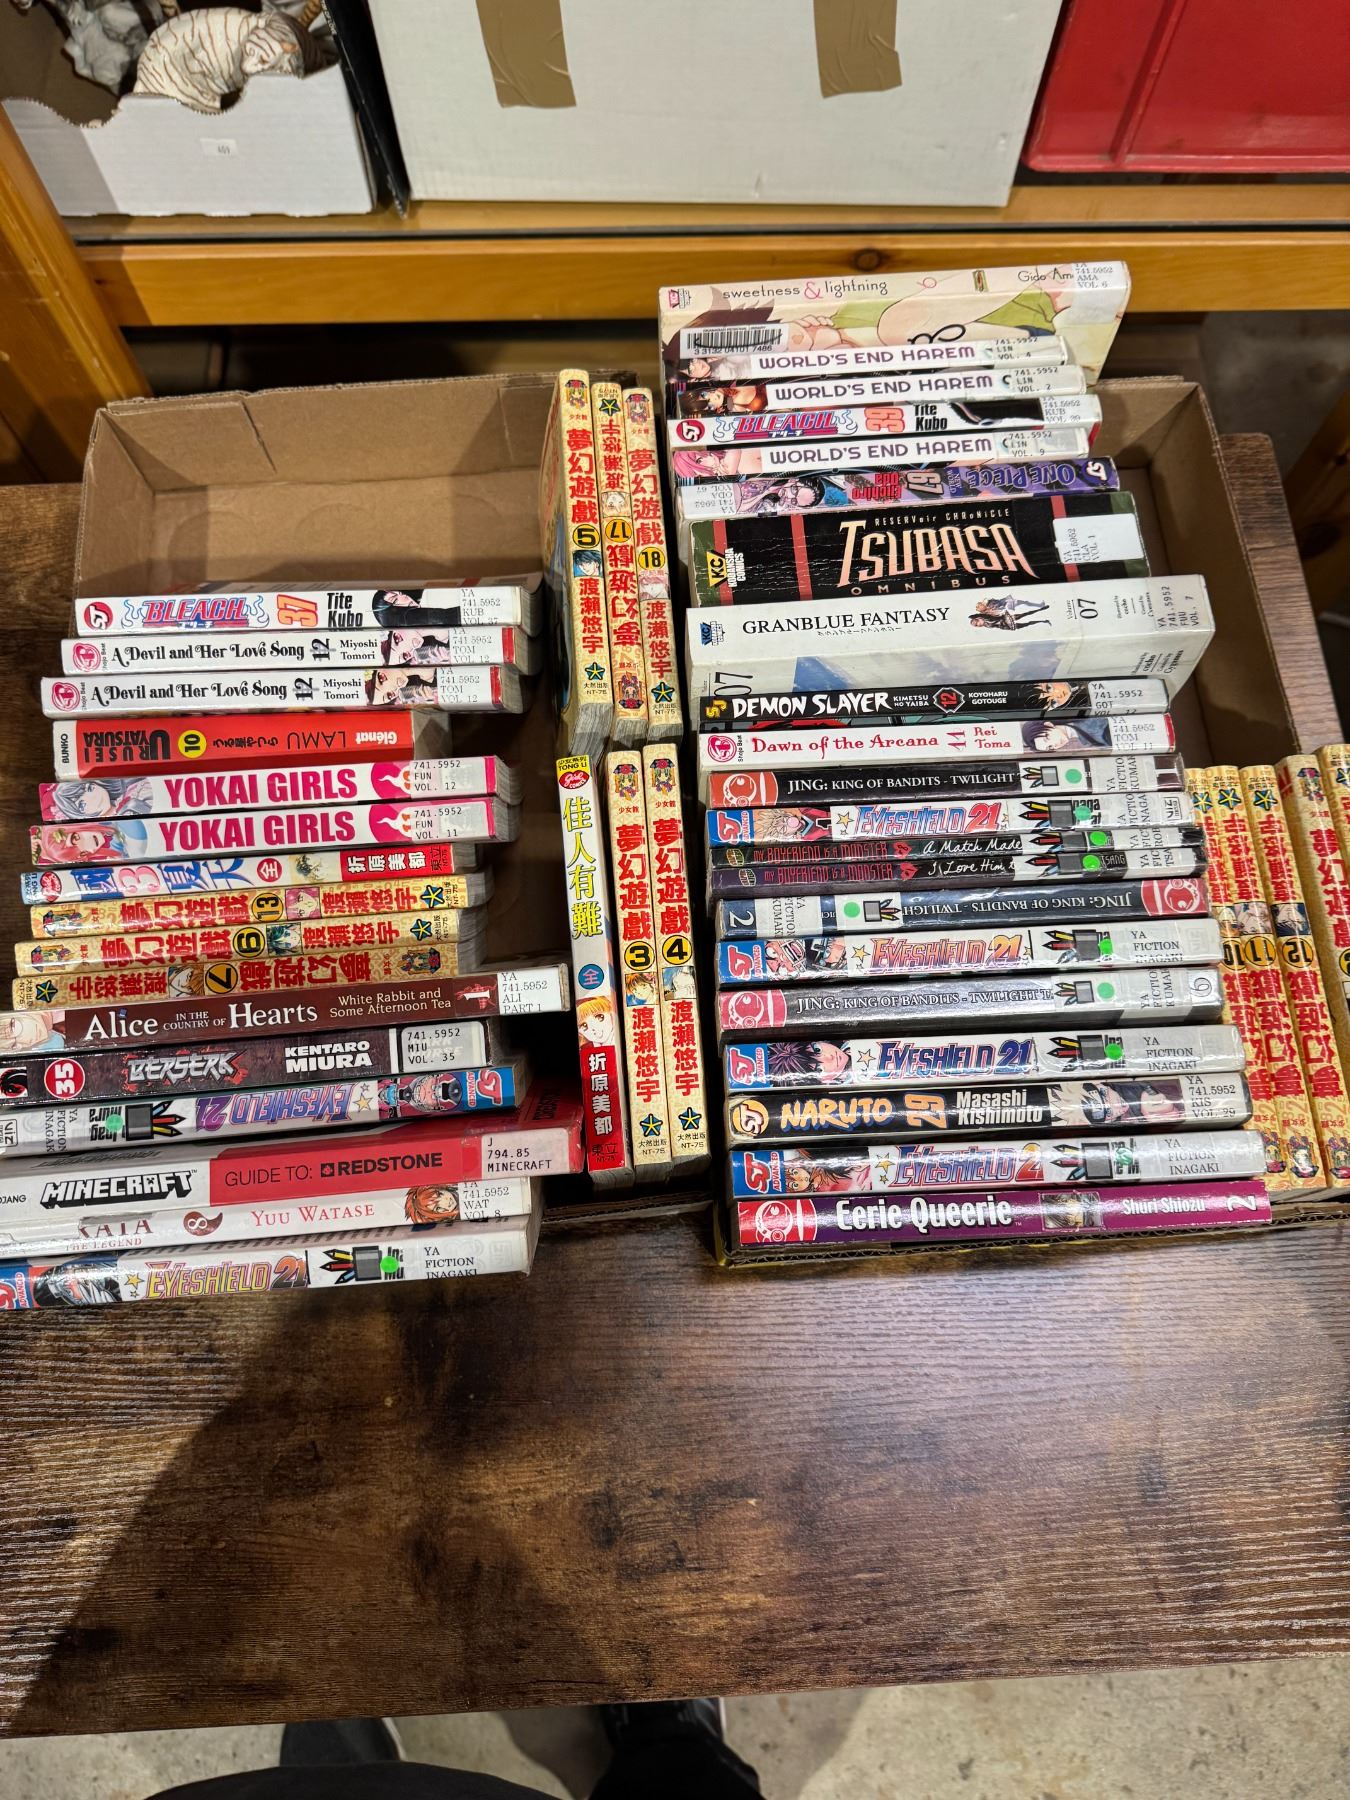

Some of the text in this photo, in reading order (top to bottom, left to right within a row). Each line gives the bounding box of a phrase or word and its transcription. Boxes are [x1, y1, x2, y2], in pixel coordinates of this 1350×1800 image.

[1017, 270, 1047, 282] Gido
[722, 278, 888, 300] sweetness lightning
[759, 346, 975, 369] WORLD'S END HAREM
[775, 375, 993, 401] WORLD'S END HAREM
[733, 404, 937, 434] BLEACH Tite
[915, 417, 948, 431] Kubo
[769, 438, 992, 465] WORLD'S END HAREM
[565, 428, 599, 525] 夢幻遊戲
[852, 466, 1029, 500] PIECE Eiichiro
[875, 472, 899, 484] Oda
[628, 448, 666, 548] 夢幻遊戲
[836, 520, 1040, 588] TSUBASA
[607, 544, 642, 647] 夢幻遊戲
[850, 575, 1011, 596] OMNIBUS
[143, 592, 353, 623] BLEACH Tite
[462, 598, 501, 607] 741.5952
[328, 610, 364, 628] Kubo
[742, 618, 855, 635] GRANBLUE
[860, 607, 950, 627] FANTASY
[125, 638, 378, 661] Devil and Her Love Song Miyoshi
[340, 651, 376, 661] Tomori
[105, 678, 362, 701] Devil and Her Love Song Miyoshi
[324, 691, 360, 701] Tomori
[1094, 690, 1144, 698] 741.5952
[732, 696, 808, 719] DEMON
[811, 692, 892, 715] SLAYER
[287, 731, 398, 750] LAMU Glénat
[752, 726, 998, 759] Dawn of the Arcana Rei
[975, 738, 1011, 749] Toma
[413, 759, 461, 770] 741.5952
[164, 768, 358, 808] YOKAI GIRLS
[787, 772, 1014, 794] JING: KING OF BANDITS TWILIGHT
[413, 807, 463, 819] 741.5952
[855, 801, 1001, 838] EYESHIELD 21
[159, 810, 356, 852] YOKAI GIRLS
[939, 836, 983, 853] Match
[346, 850, 427, 874] 折原美都
[615, 823, 654, 942] 夢幻遊戲
[652, 817, 692, 936] 夢幻遊戲
[972, 891, 1133, 912] JING: KING OF BANDITS
[119, 894, 250, 934] 夢幻遊戲
[99, 928, 234, 969] 夢幻遊戲
[628, 945, 652, 968] 3
[666, 938, 688, 961] 4
[870, 936, 987, 970] EYESHIELD
[1133, 940, 1180, 951] FICTION
[240, 951, 372, 992] 夢幻遊戲
[562, 795, 614, 1137] 佳人有難 折原美都
[502, 980, 548, 992] 741.5952
[329, 998, 452, 1019] Some Afternoon Tea
[338, 989, 442, 1008] White Rabbit and
[502, 993, 522, 1003] ALI
[796, 988, 1038, 1014] JING: KING OF BANDITS TWILIGHT
[83, 1002, 318, 1040] Alice COUNTRY OF Hearts
[188, 1011, 210, 1021] THE
[406, 1027, 461, 1040] 741.5952
[284, 1053, 373, 1074] MIURA
[407, 1054, 435, 1065] VOL.
[876, 1040, 995, 1080] EYESHIELD
[1145, 1047, 1194, 1058] FICTION
[53, 1039, 371, 1096] 35 BERSERK KENTARO
[1185, 1075, 1203, 1085] YA
[1188, 1084, 1237, 1096] 741.5952
[230, 1083, 356, 1127] EYESHIELD
[781, 1088, 1027, 1132] NARUTO 29 Masashi
[958, 1104, 1043, 1126] Kishimoto
[487, 1147, 531, 1159] 794.85
[1168, 1151, 1216, 1161] FICTION
[487, 1159, 552, 1173] MINECRAFT
[1170, 1163, 1219, 1174] INAGAKI
[39, 1152, 443, 1211] MINECRAFT GUIDE TO: REDSTONE
[462, 1187, 510, 1199] 741.5952
[250, 1203, 376, 1228] YUU WATASE
[463, 1199, 490, 1210] WAT
[836, 1194, 1206, 1234] Eerie Queerie Shuri Shiozu
[423, 1246, 441, 1256] YA
[424, 1256, 475, 1269] FICTION
[146, 1253, 272, 1300] EYESHIELD
